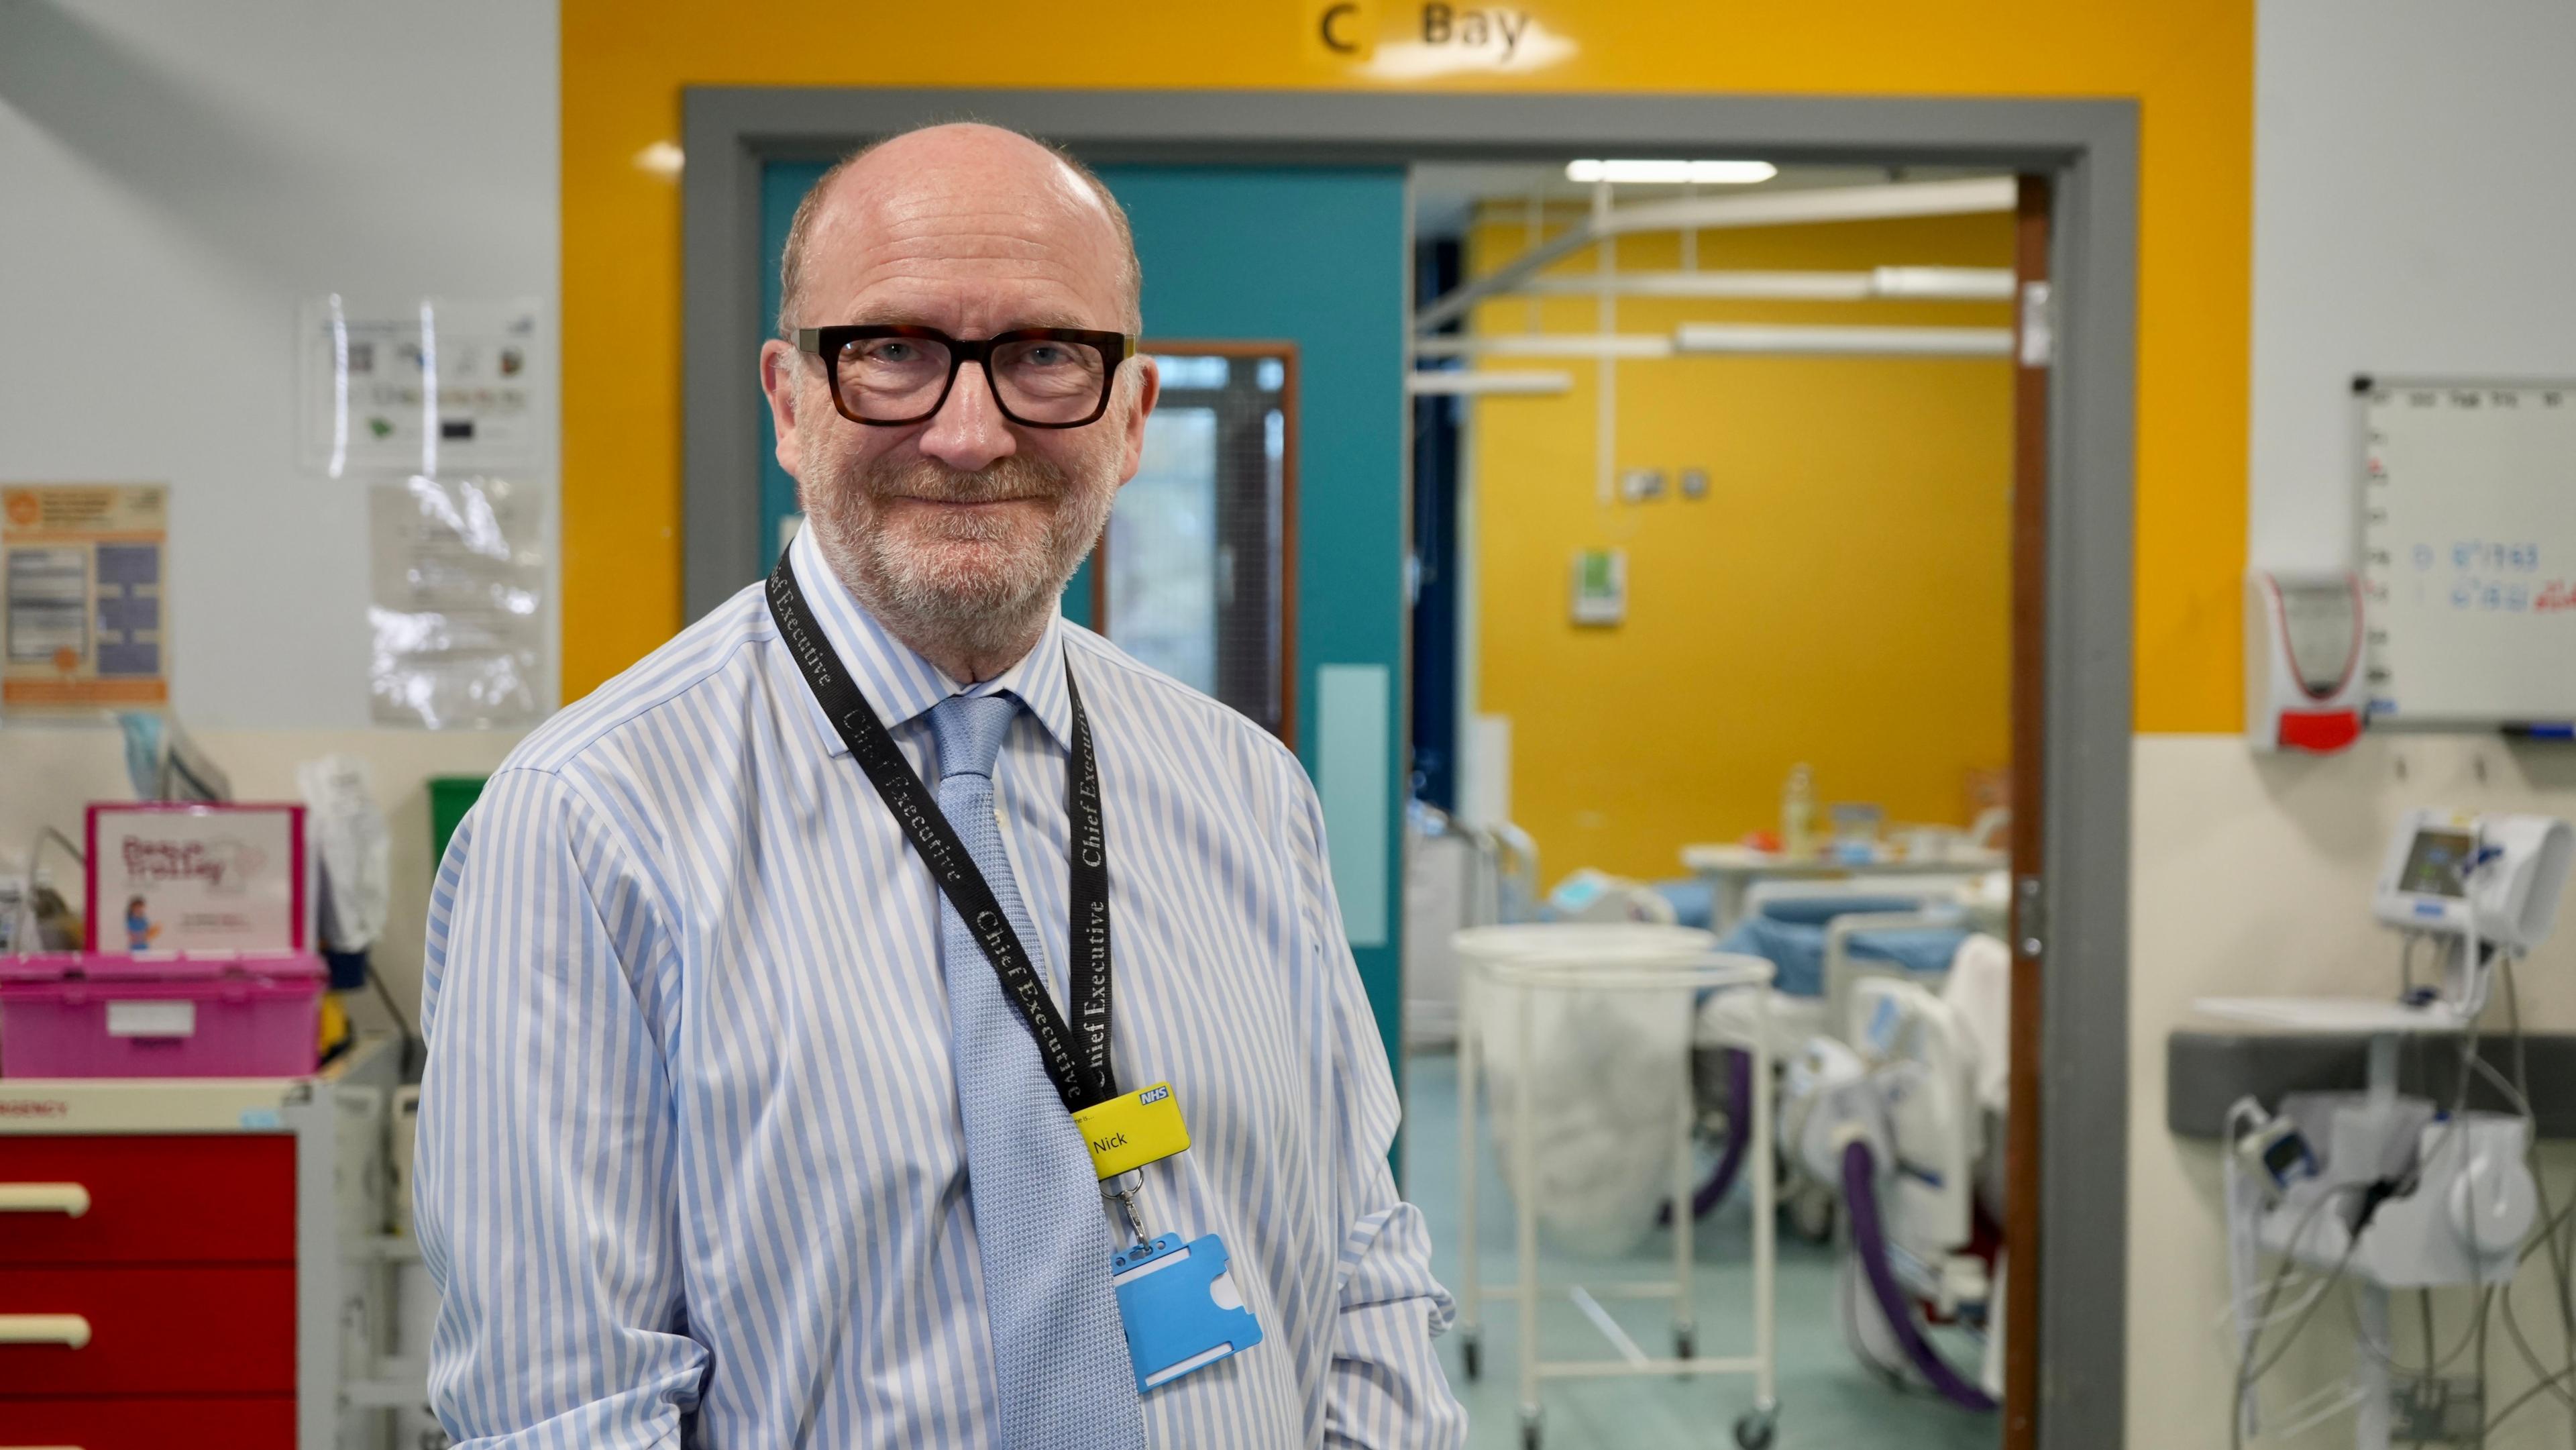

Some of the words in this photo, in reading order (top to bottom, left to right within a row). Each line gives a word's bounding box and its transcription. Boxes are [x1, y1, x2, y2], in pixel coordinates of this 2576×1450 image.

[1320, 3, 1360, 54] C
[1424, 1, 1530, 62] Bay
[777, 588, 831, 686] Executive
[1076, 698, 1096, 799] Executive
[1080, 800, 1101, 867] Chief
[1084, 900, 1106, 1015] Executive
[977, 911, 1027, 977] Chief
[1017, 980, 1081, 1098] Executive
[1141, 1086, 1168, 1104] NHS
[1093, 1133, 1127, 1153] Nick
